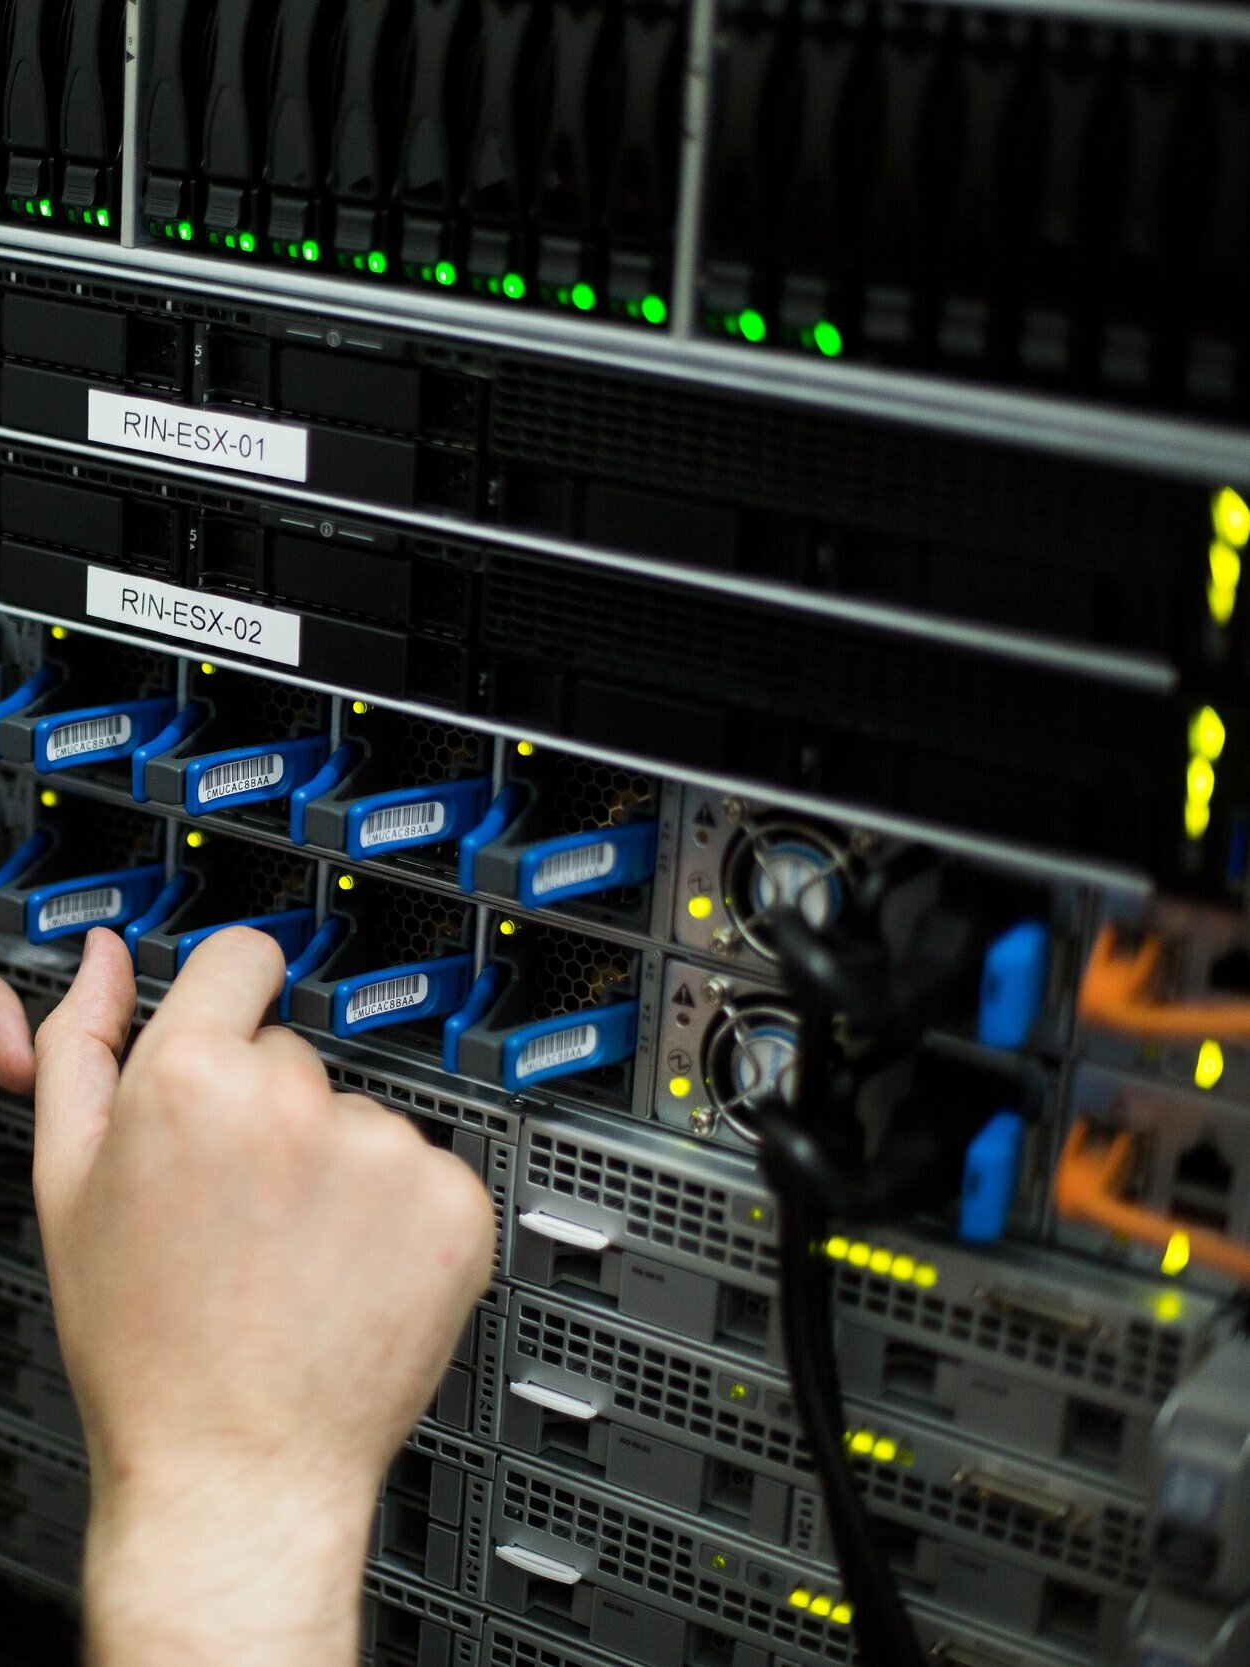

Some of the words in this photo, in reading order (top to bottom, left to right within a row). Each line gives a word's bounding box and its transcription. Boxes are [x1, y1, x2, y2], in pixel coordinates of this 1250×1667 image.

[194, 345, 202, 357] 5
[123, 411, 266, 461] RIN-ESX-01
[189, 529, 197, 541] 5
[121, 588, 263, 645] RIN-ESX-02
[55, 736, 118, 759] CMUCAC8BAA
[206, 774, 270, 800] CMUCAC8BAA
[353, 995, 414, 1020] CMUCAC8BAA
